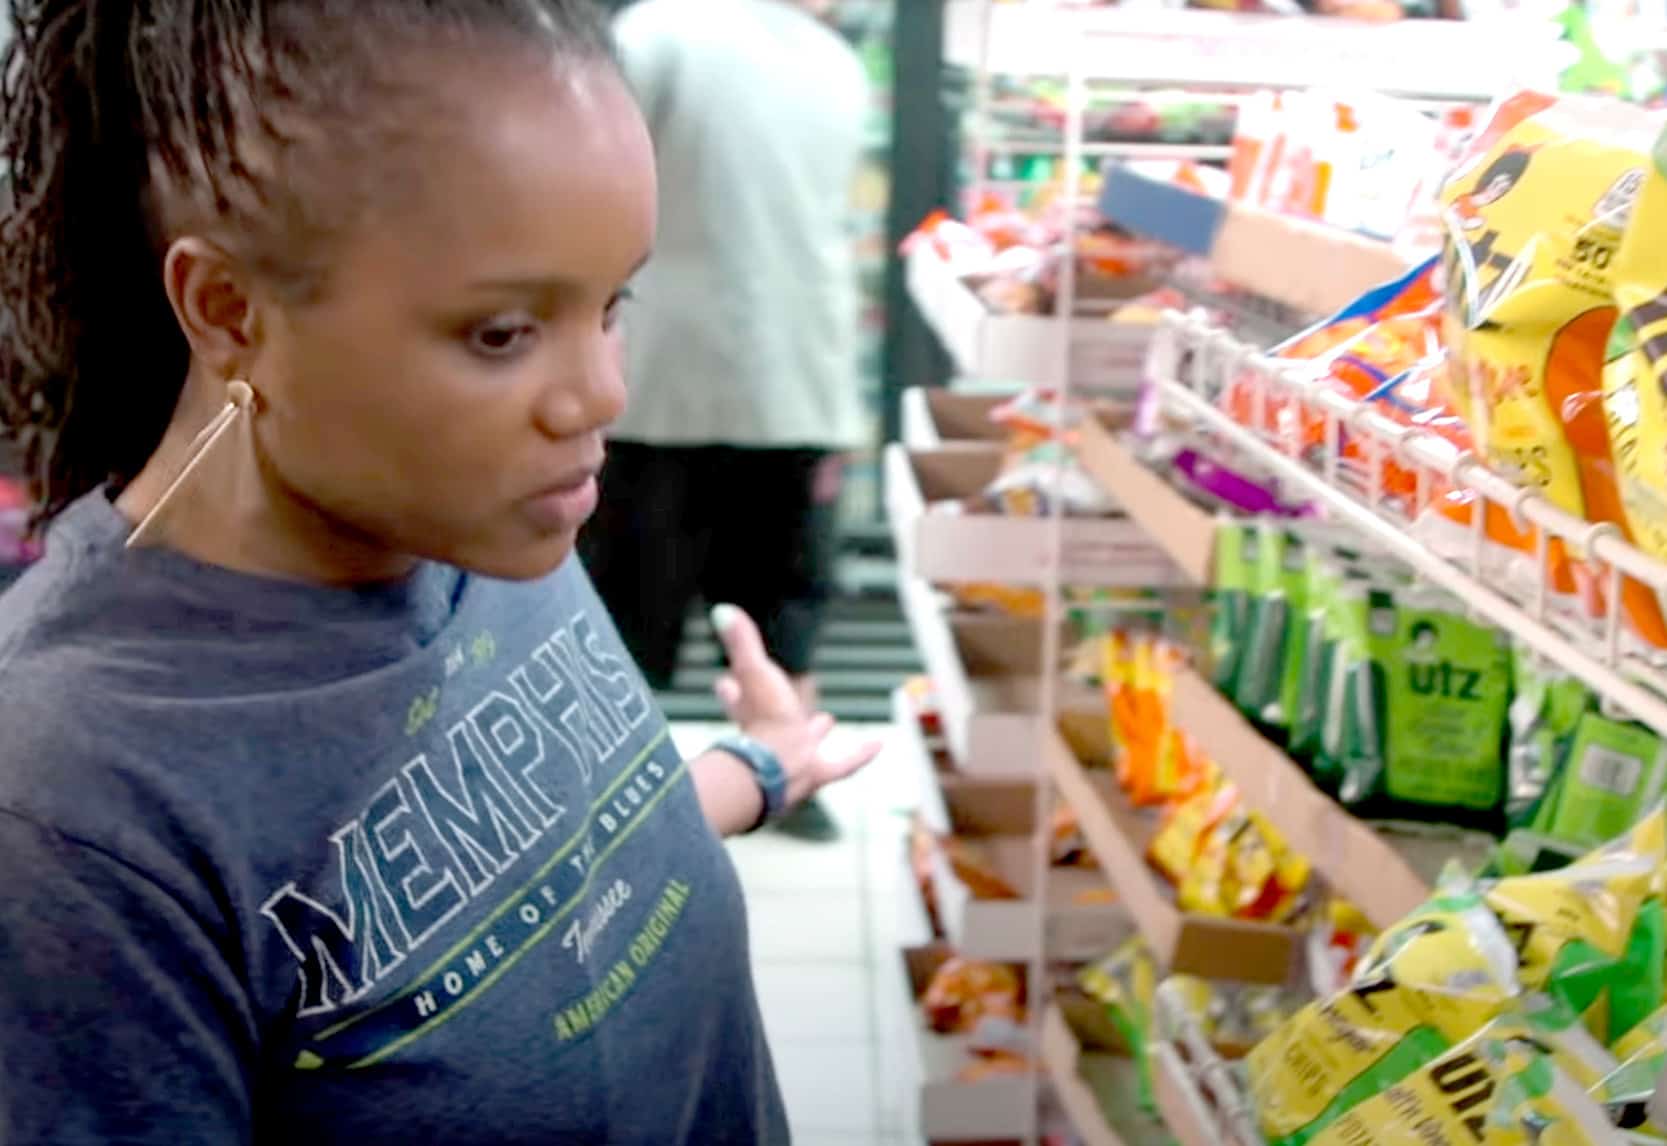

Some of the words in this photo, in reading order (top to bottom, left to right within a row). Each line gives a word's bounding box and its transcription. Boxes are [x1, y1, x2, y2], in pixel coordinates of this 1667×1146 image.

[262, 609, 650, 1018] MEMPHIS
[413, 933, 505, 1017] HOME
[518, 884, 557, 925] OF
[598, 760, 665, 833] BLUES
[628, 878, 690, 968] ORIGINAL
